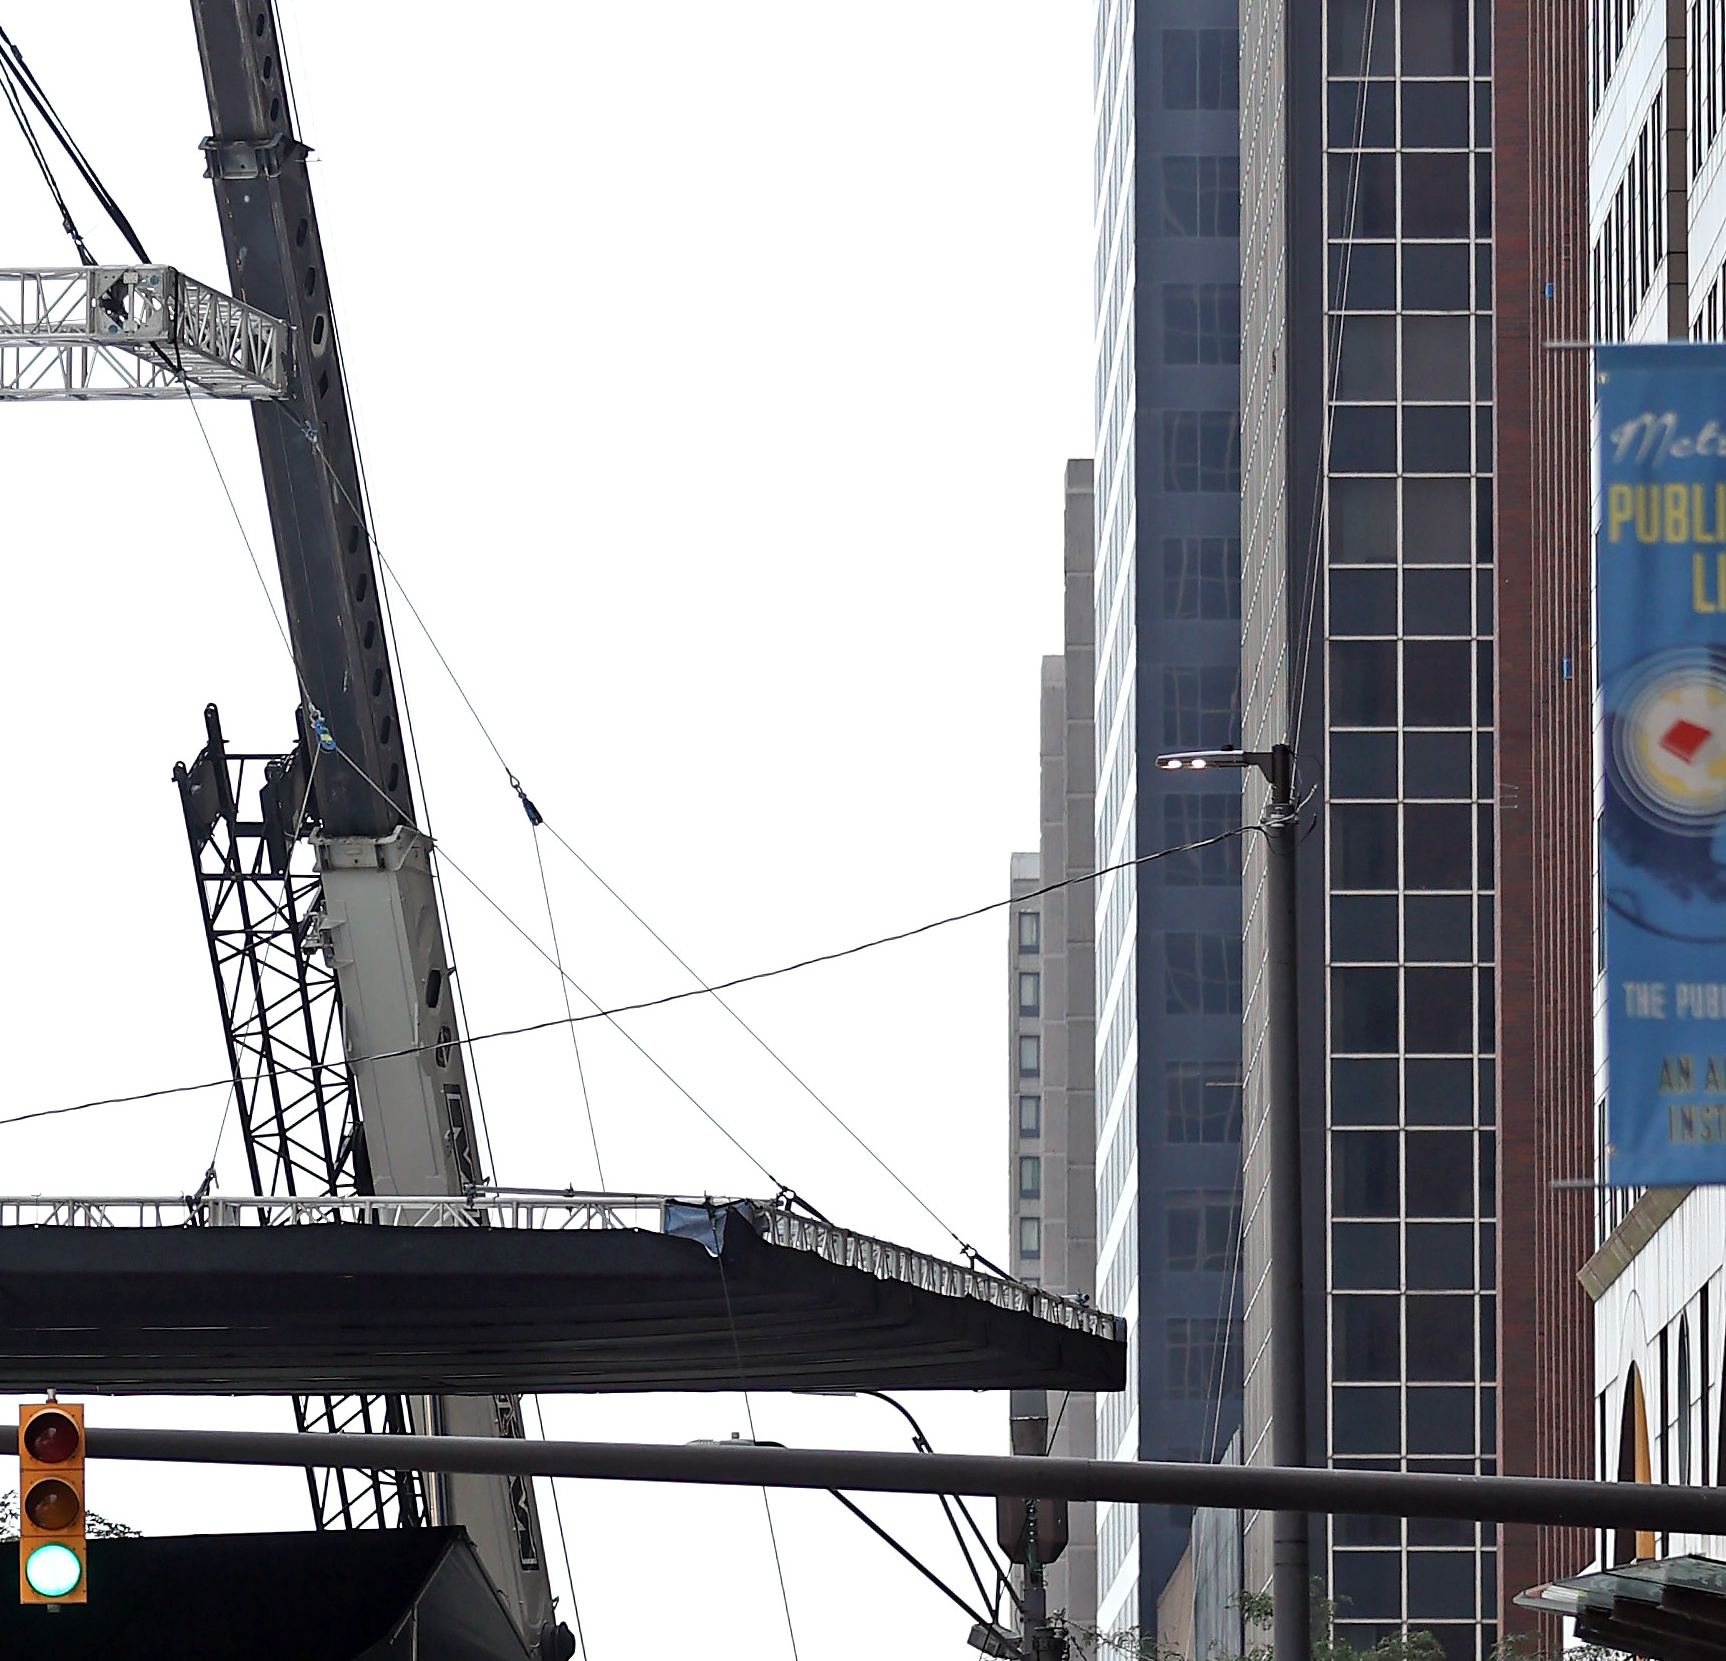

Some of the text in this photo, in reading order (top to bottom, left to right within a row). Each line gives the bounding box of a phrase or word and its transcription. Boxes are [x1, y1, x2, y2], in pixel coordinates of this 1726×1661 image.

[1623, 981, 1667, 1020] THE
[1658, 1053, 1726, 1094] AN A
